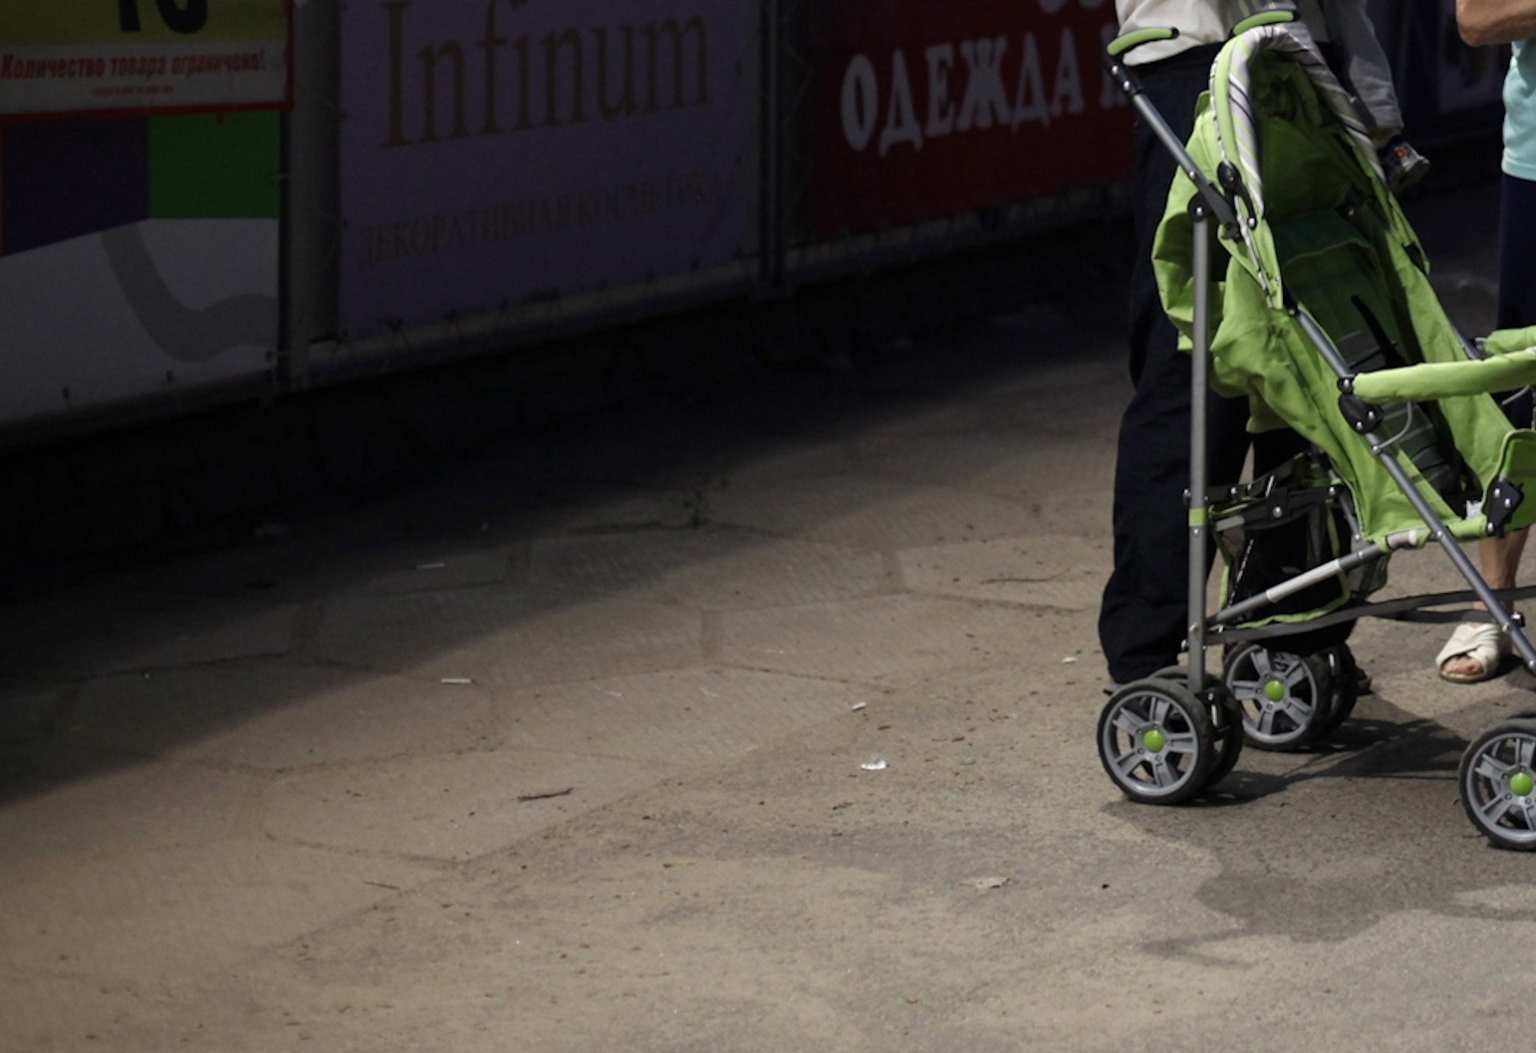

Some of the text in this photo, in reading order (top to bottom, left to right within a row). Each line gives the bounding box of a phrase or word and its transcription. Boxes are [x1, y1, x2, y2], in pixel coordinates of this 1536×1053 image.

[1, 47, 266, 80] Количество товара ограничено!
[840, 27, 1086, 157] ОДЕЖДА
